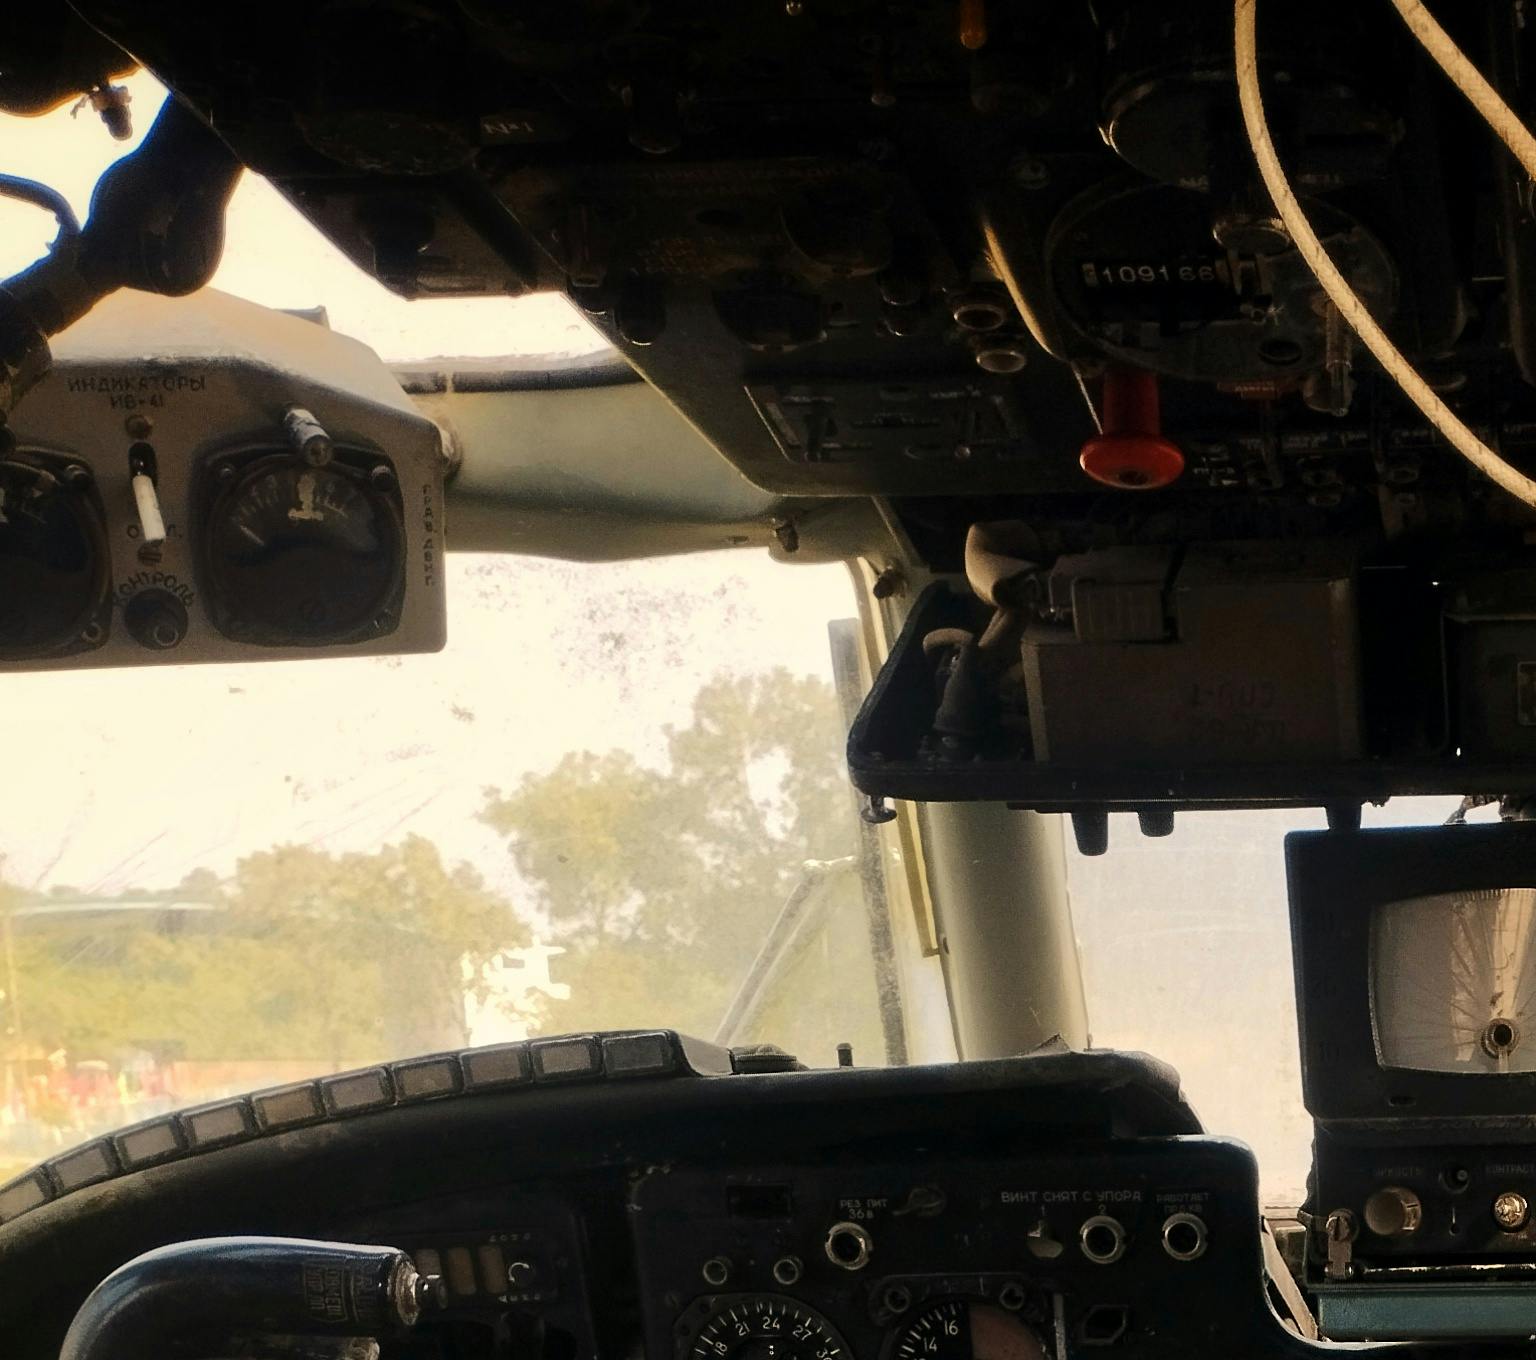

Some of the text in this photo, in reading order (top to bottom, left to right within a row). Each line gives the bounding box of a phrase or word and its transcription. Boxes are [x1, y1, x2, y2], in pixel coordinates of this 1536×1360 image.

[67, 376, 206, 392] ИНДИКАТОРЫ
[1001, 1192, 1038, 1202] ВИНТ
[1042, 1192, 1078, 1202] СНЯТ
[792, 1325, 812, 1340] 27
[944, 1320, 959, 1336] 16
